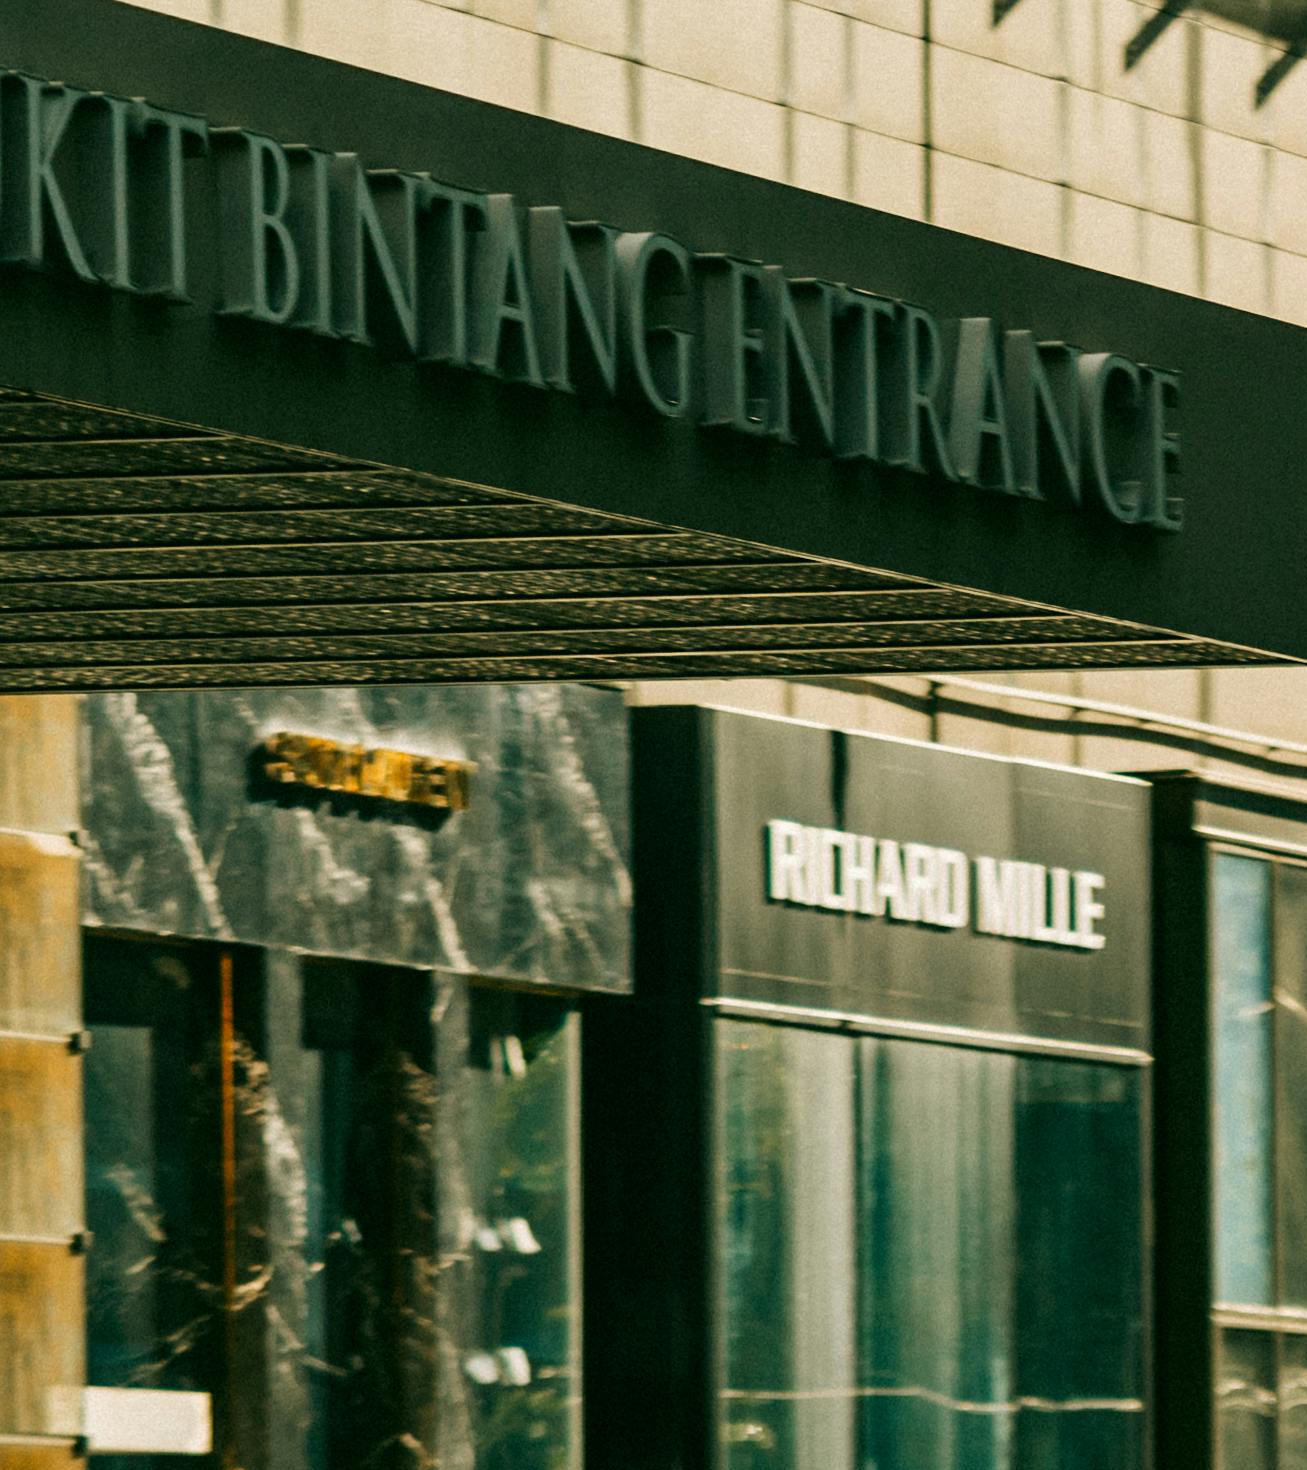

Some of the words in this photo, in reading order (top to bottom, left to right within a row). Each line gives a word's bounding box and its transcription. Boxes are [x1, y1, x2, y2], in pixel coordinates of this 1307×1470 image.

[210, 126, 695, 418] BINTANG
[694, 252, 1184, 532] ENTRANCE
[766, 818, 969, 929] RICHARD
[973, 856, 1106, 951] MILLE
